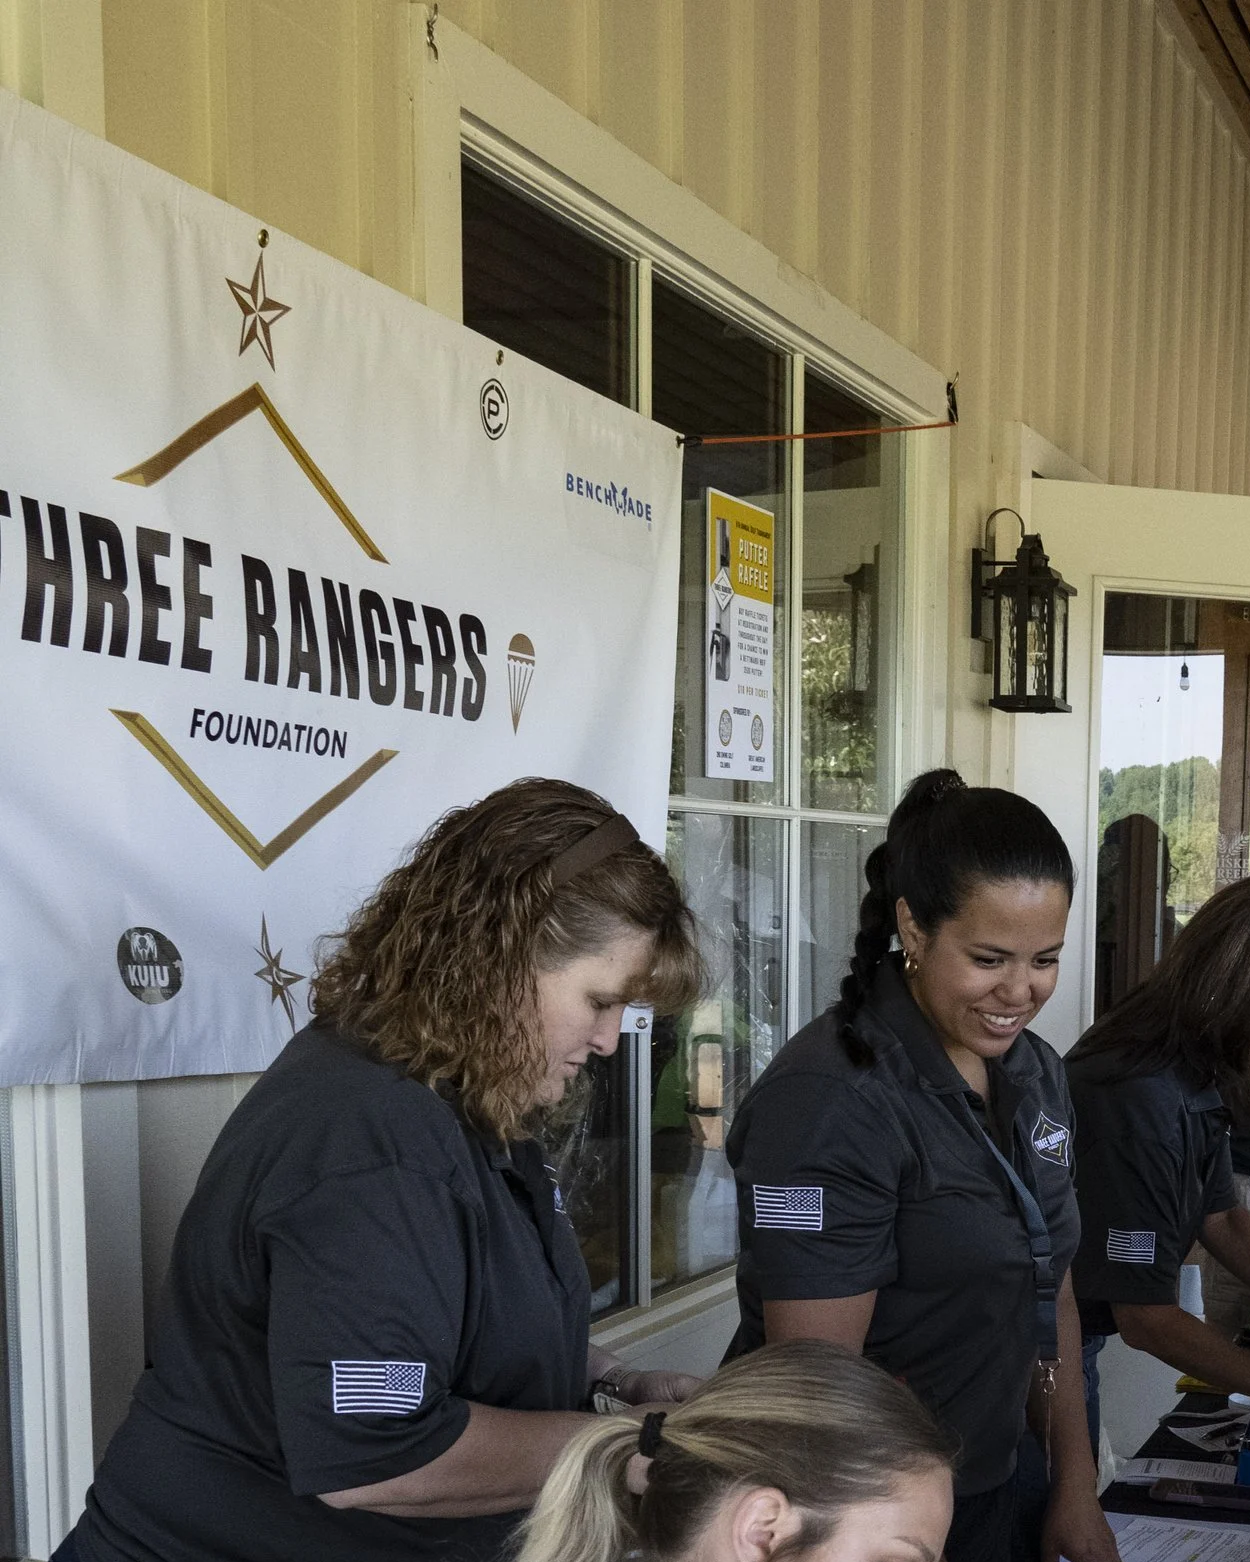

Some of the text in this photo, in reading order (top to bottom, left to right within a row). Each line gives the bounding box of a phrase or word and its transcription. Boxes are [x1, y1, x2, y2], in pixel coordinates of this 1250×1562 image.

[738, 538, 769, 567] PUTTER
[738, 562, 769, 593] RAFFLE
[241, 553, 488, 722] RANGERS
[189, 708, 348, 759] FOUNDATION
[127, 964, 170, 988] KUIU
